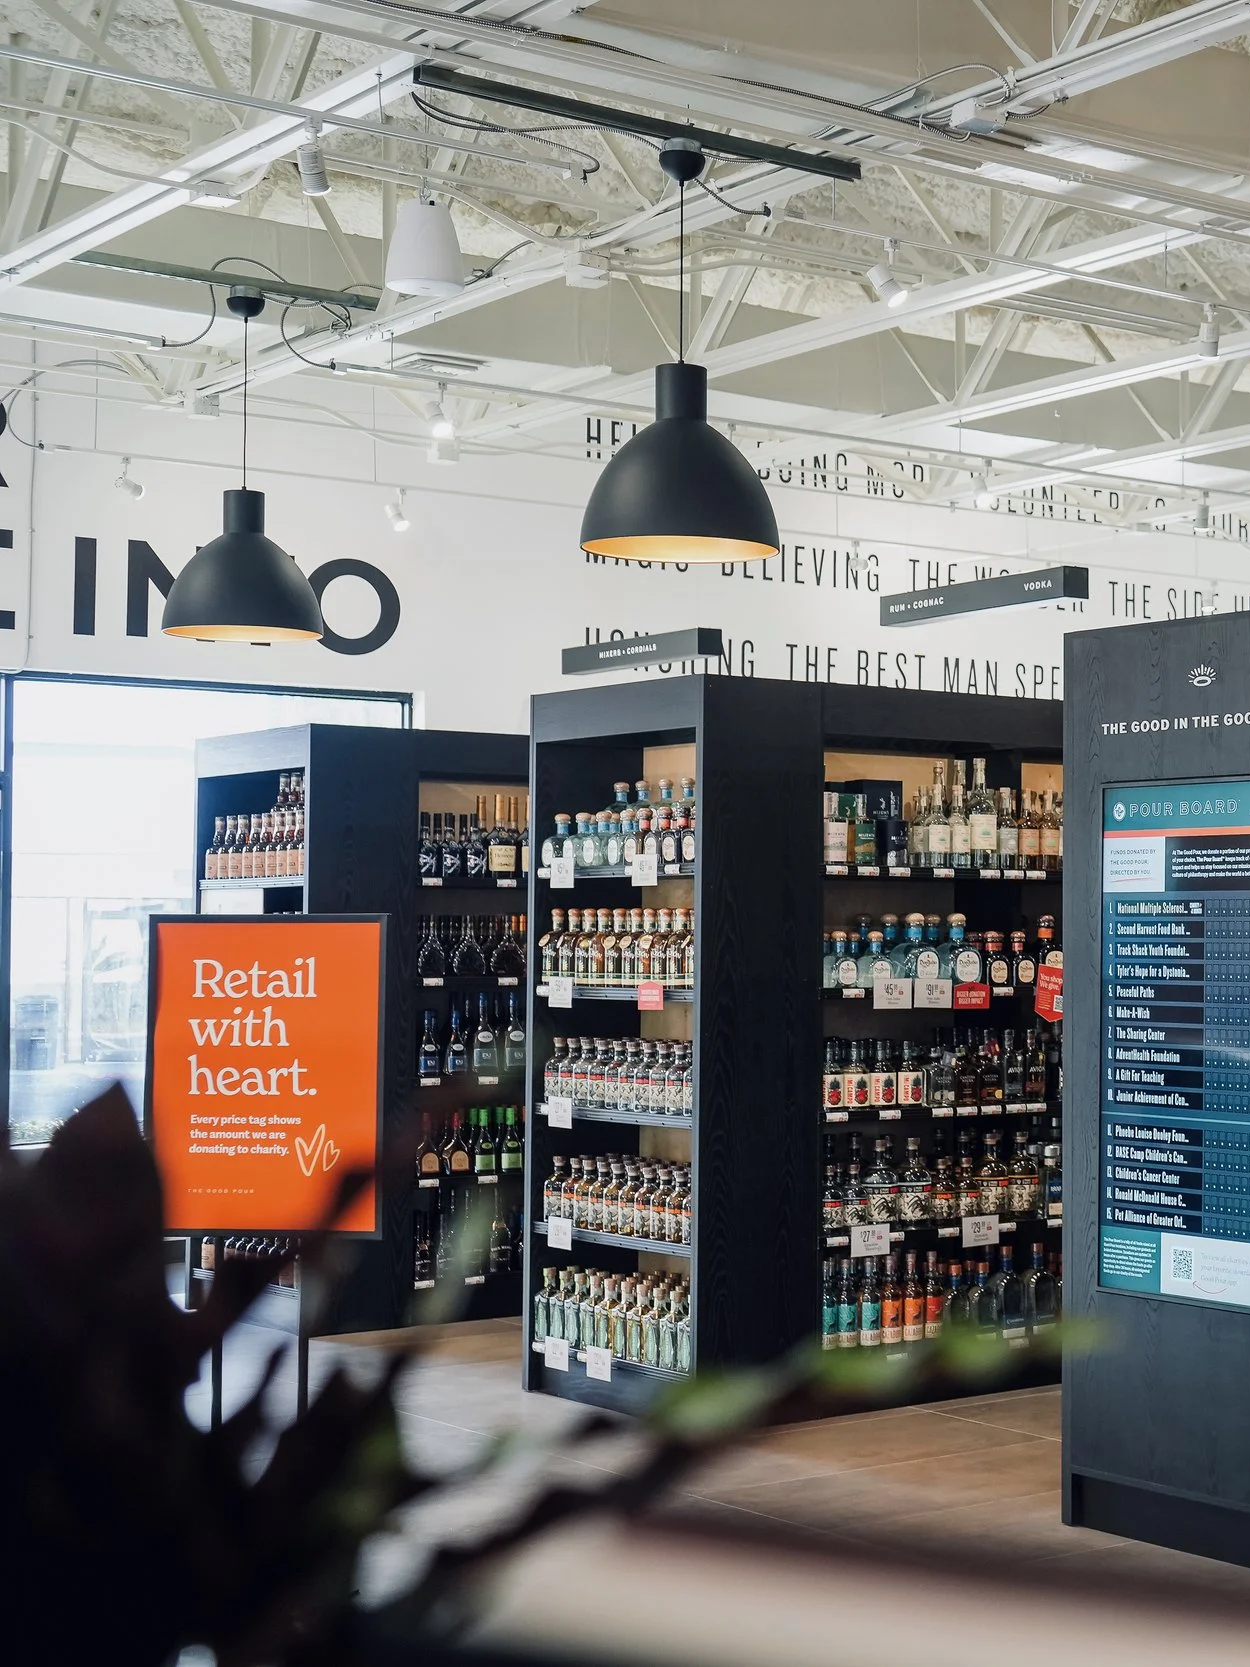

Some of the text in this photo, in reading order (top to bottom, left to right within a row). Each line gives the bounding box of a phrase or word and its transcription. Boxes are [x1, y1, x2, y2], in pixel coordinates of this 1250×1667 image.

[1024, 580, 1052, 591] VODKA
[74, 537, 400, 655] INO
[1109, 581, 1151, 619] THE
[890, 597, 944, 613] RUM COGNAC
[627, 644, 656, 655] CORDIALS
[786, 644, 838, 683] THE
[858, 650, 925, 691] BEST
[944, 657, 998, 697] MAN
[1102, 722, 1127, 735] THE
[1131, 719, 1170, 733] GOOD
[1174, 717, 1188, 730] IN
[1192, 715, 1220, 728] THE
[1130, 799, 1238, 817] POUR BOARD
[1118, 902, 1139, 914] National
[1140, 902, 1161, 916] Multiple
[1117, 923, 1136, 935] Second
[1137, 923, 1157, 935] Harvest
[1158, 923, 1170, 935] Food
[1172, 923, 1185, 935] Bank
[1117, 944, 1131, 956] Track
[1132, 944, 1148, 956] Shack
[1149, 944, 1163, 956] Youth
[192, 957, 317, 998] Retail
[1117, 964, 1134, 978] Tyler's
[1135, 965, 1148, 979] Hope
[1149, 965, 1157, 977] for
[1158, 968, 1161, 977] a
[1117, 986, 1139, 997] Peaceful
[1140, 986, 1154, 998] Paths
[1116, 1006, 1150, 1019] Make-A-Wish
[188, 1006, 289, 1047] with
[1116, 1027, 1126, 1039] The
[1127, 1027, 1147, 1042] Sharing
[1148, 1028, 1165, 1040] Center
[1116, 1048, 1150, 1061] AdventHealth
[1151, 1050, 1180, 1062] Foundation
[187, 1055, 317, 1096] heart.
[1116, 1069, 1120, 1080] A
[1121, 1069, 1130, 1081] Gift
[1132, 1070, 1140, 1081] For
[1141, 1070, 1164, 1086] Teaching
[1116, 1090, 1133, 1102] Junior
[1134, 1091, 1167, 1104] Achievement
[1168, 1093, 1174, 1105] of
[190, 1114, 301, 1126] Every price tag shows
[190, 1129, 286, 1139] the amount we are
[1116, 1125, 1134, 1138] Phoebe
[1135, 1127, 1152, 1139] Louise
[189, 1144, 289, 1156] donating to charity.
[1116, 1146, 1129, 1158] BASE
[1130, 1147, 1144, 1162] Camp
[1145, 1148, 1172, 1162] Children's
[1116, 1167, 1142, 1180] Children's
[1143, 1169, 1161, 1182] Cancer
[1162, 1171, 1180, 1184] Center
[1115, 1188, 1133, 1201] Ronald
[1134, 1190, 1159, 1204] McDonald
[1161, 1193, 1177, 1205] House
[1125, 1210, 1146, 1223] Alliance
[1146, 1213, 1152, 1224] of
[1153, 1213, 1173, 1226] Greater
